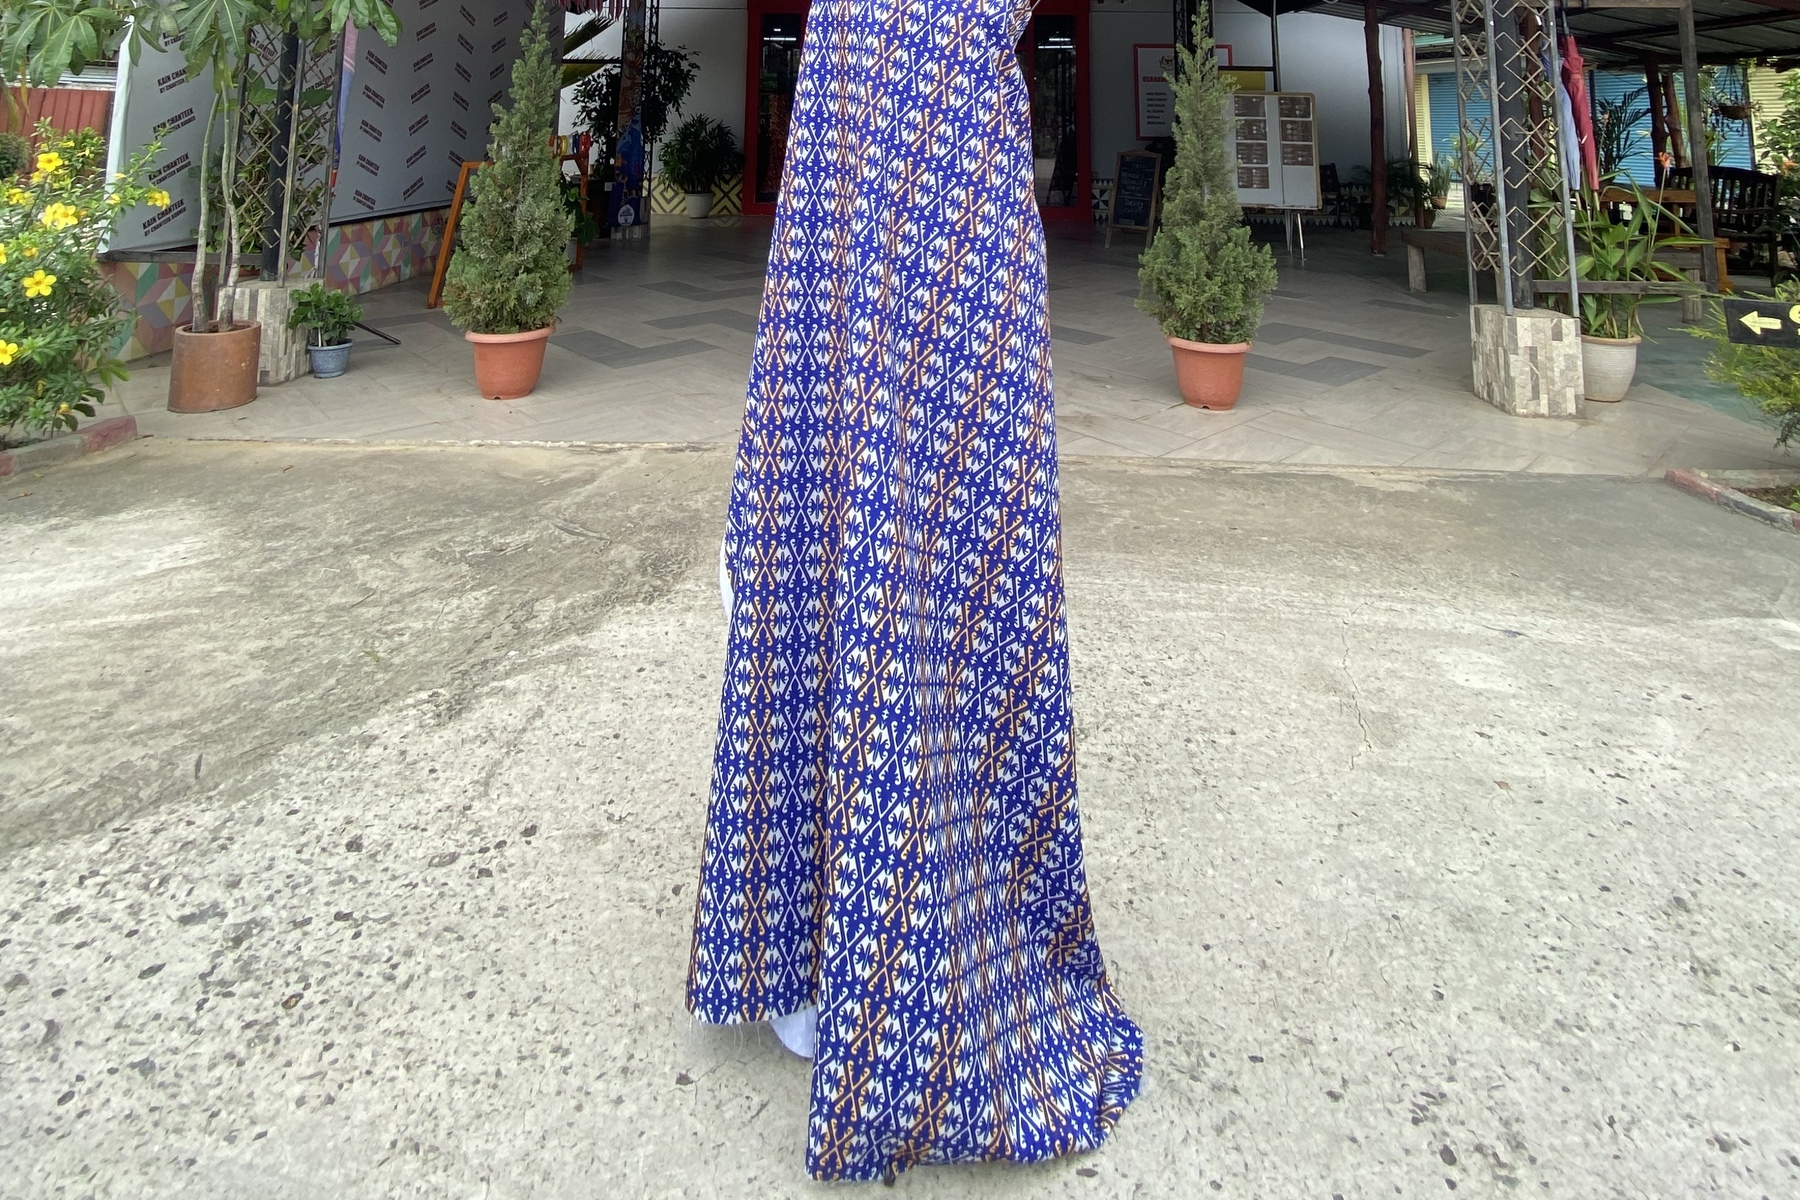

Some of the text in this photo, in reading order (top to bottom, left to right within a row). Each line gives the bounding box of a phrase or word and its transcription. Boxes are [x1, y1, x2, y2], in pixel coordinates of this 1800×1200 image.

[172, 67, 187, 80] CHAN
[167, 107, 194, 126] CHANTEEK
[163, 152, 189, 172] CHANTEEK
[143, 199, 184, 230] KAIN CHANTEEK
